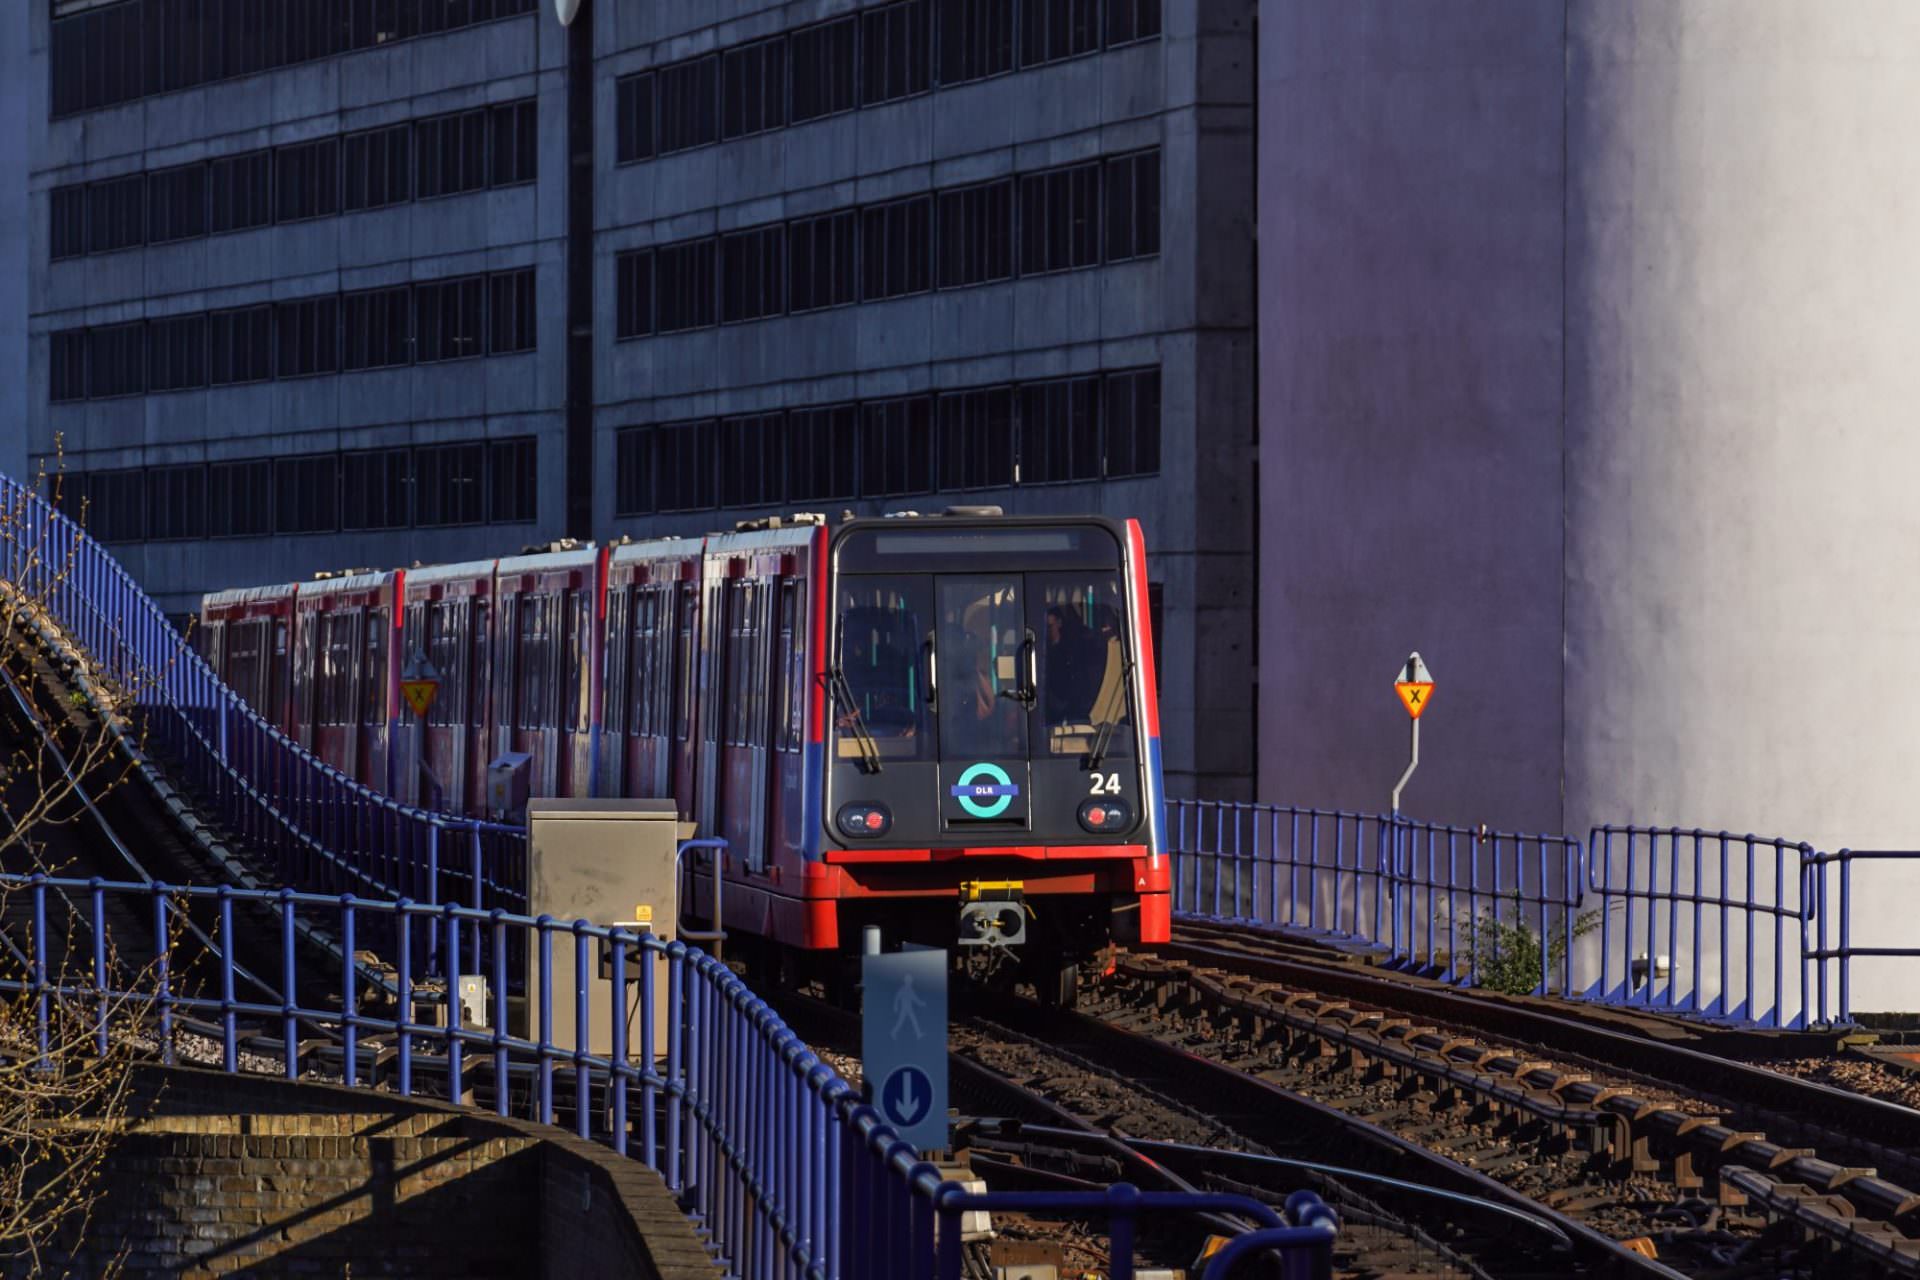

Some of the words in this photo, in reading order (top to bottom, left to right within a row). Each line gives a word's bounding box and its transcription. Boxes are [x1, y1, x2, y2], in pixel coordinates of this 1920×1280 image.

[1410, 689, 1421, 703] X
[975, 786, 993, 795] DLR
[1090, 772, 1121, 795] 24
